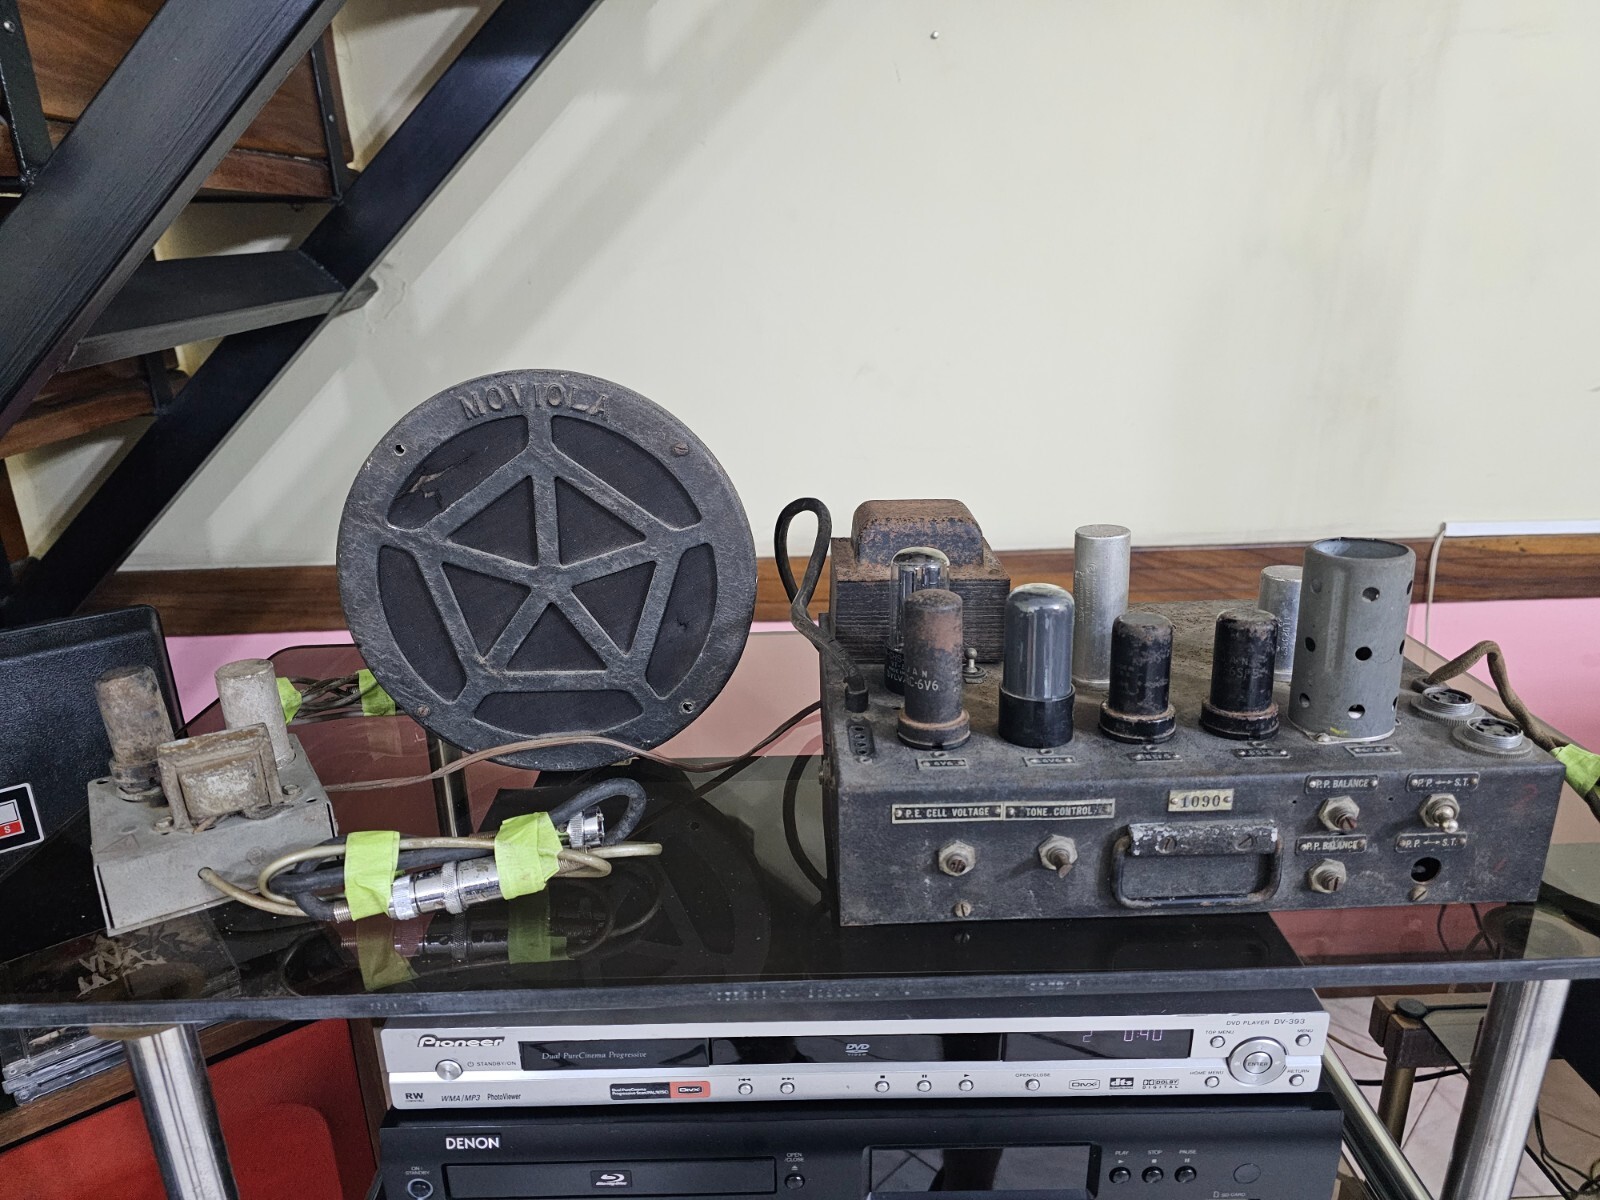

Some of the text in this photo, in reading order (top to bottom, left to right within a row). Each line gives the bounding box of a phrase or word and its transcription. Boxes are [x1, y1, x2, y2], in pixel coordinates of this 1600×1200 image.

[458, 382, 610, 421] MOVIOLA
[1315, 779, 1369, 788] P.P. BALANCE
[1417, 778, 1469, 787] P.P. S.T.
[905, 807, 990, 818] P.E. CELL VOLTAGE
[1025, 806, 1093, 817] TONE CONTROL
[1322, 840, 1358, 850] BALANCE
[418, 1034, 504, 1048] Pioneer
[541, 1050, 647, 1060] Dual PureCinema Progressive
[1110, 1078, 1133, 1087] dts
[405, 1092, 424, 1100] RW
[441, 1093, 521, 1102] WMA/MP3 PhotoViewer
[445, 1137, 500, 1150] DENON
